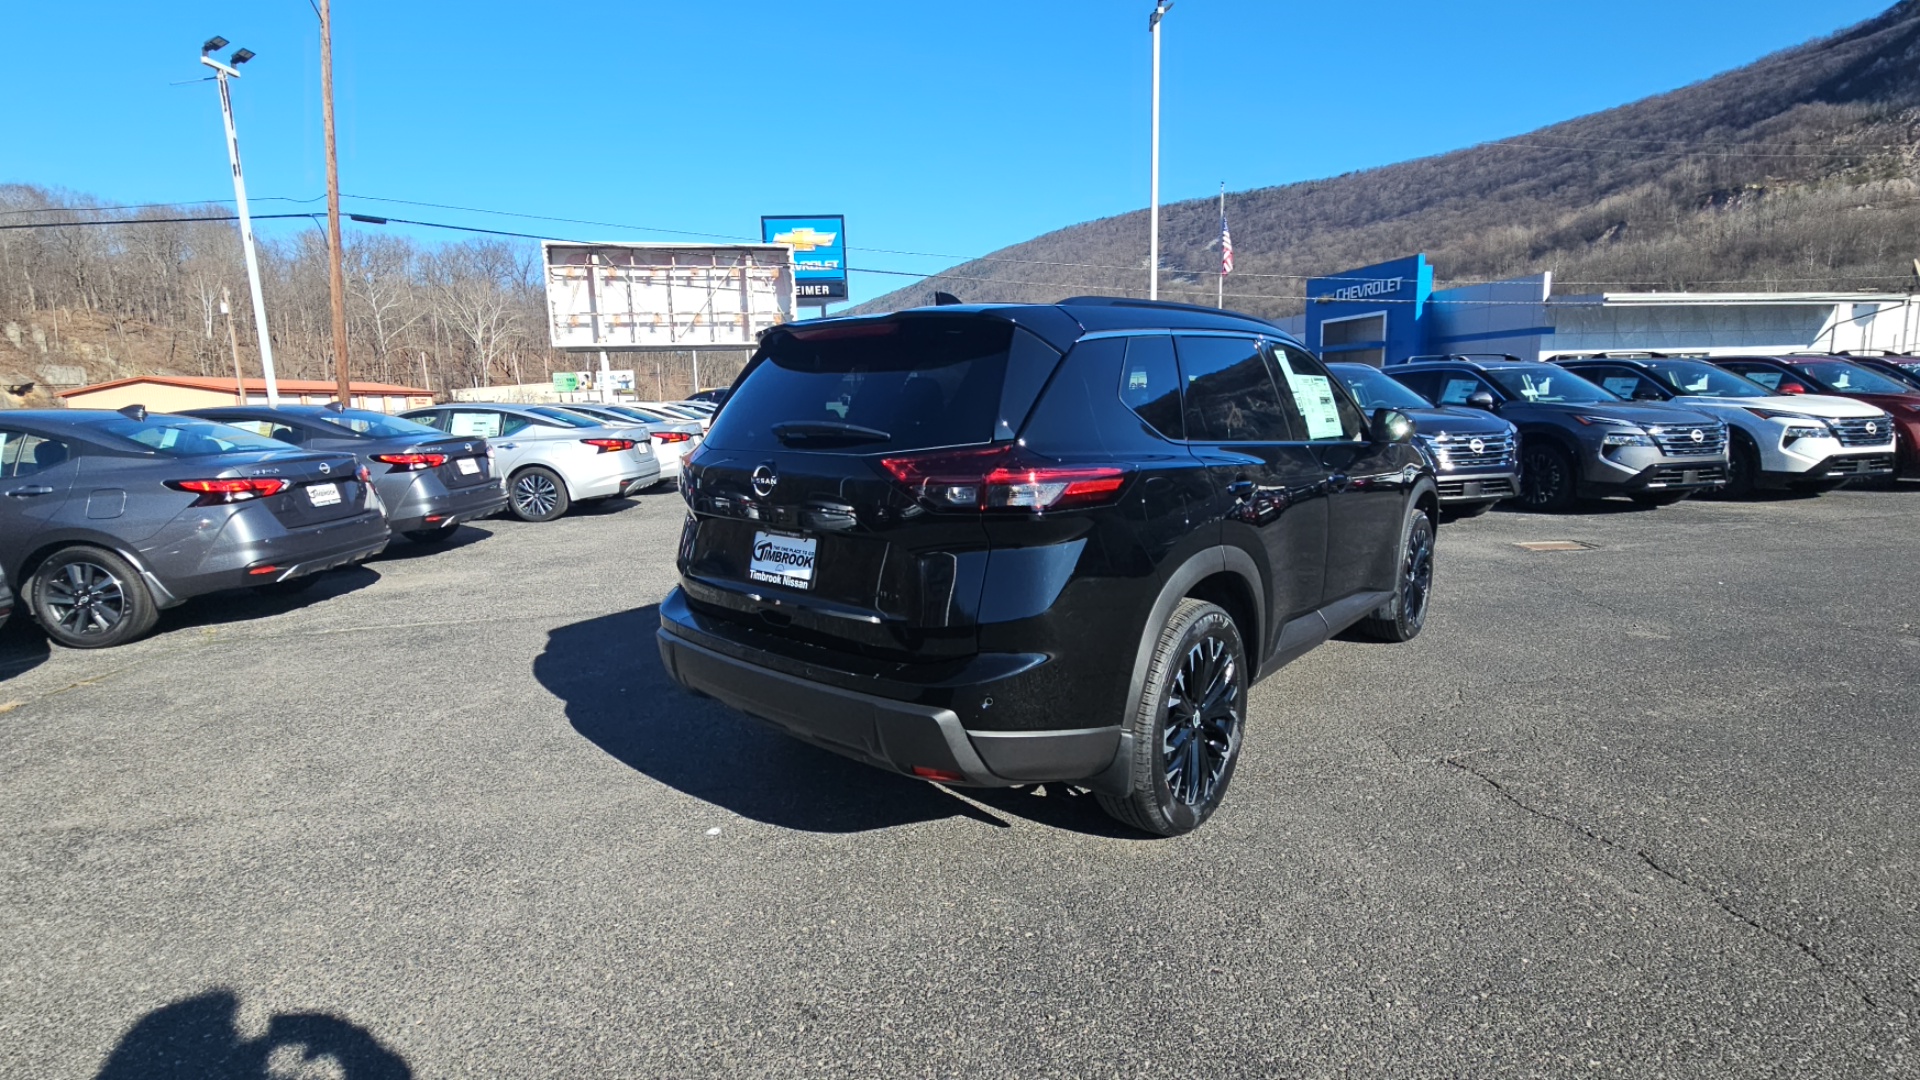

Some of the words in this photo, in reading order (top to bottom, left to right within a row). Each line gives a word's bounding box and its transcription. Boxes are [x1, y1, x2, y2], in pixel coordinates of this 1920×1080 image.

[1336, 276, 1403, 299] CHEVROLET
[753, 540, 814, 568] TIMBROOK
[750, 569, 782, 585] Timbrook
[782, 575, 808, 590] Nissan
